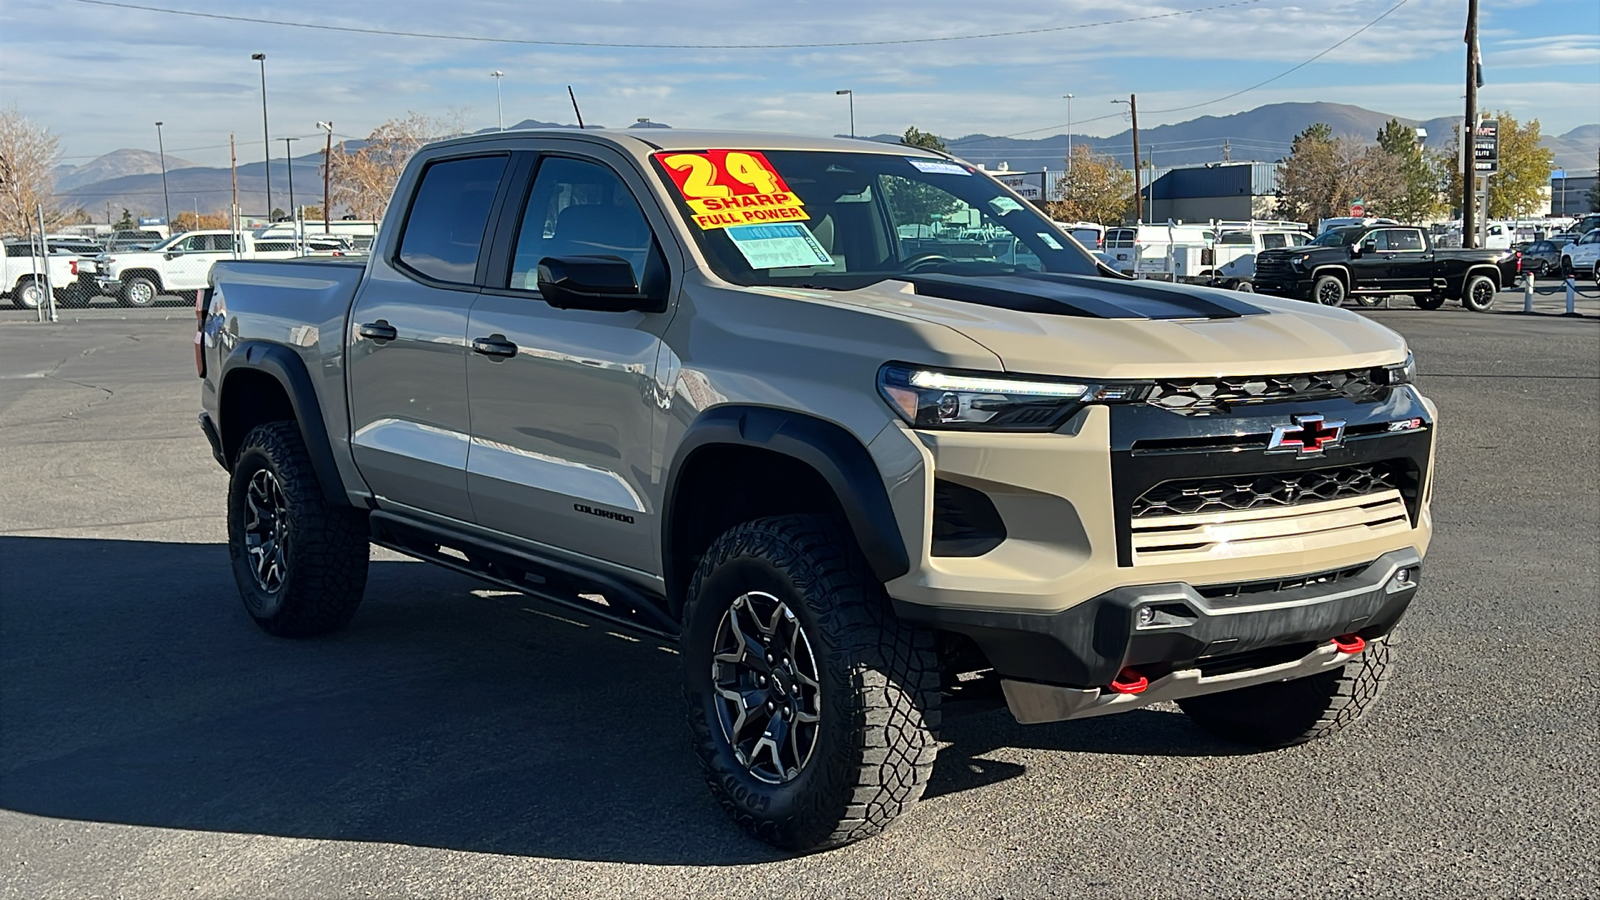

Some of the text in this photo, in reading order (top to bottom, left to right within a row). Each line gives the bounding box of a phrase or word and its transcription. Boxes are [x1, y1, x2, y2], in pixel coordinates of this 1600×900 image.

[663, 152, 780, 198] 24
[702, 193, 791, 211] SHARP
[697, 207, 803, 227] FULL POWER
[1388, 418, 1421, 432] ZR2
[573, 503, 635, 524] COLORADO
